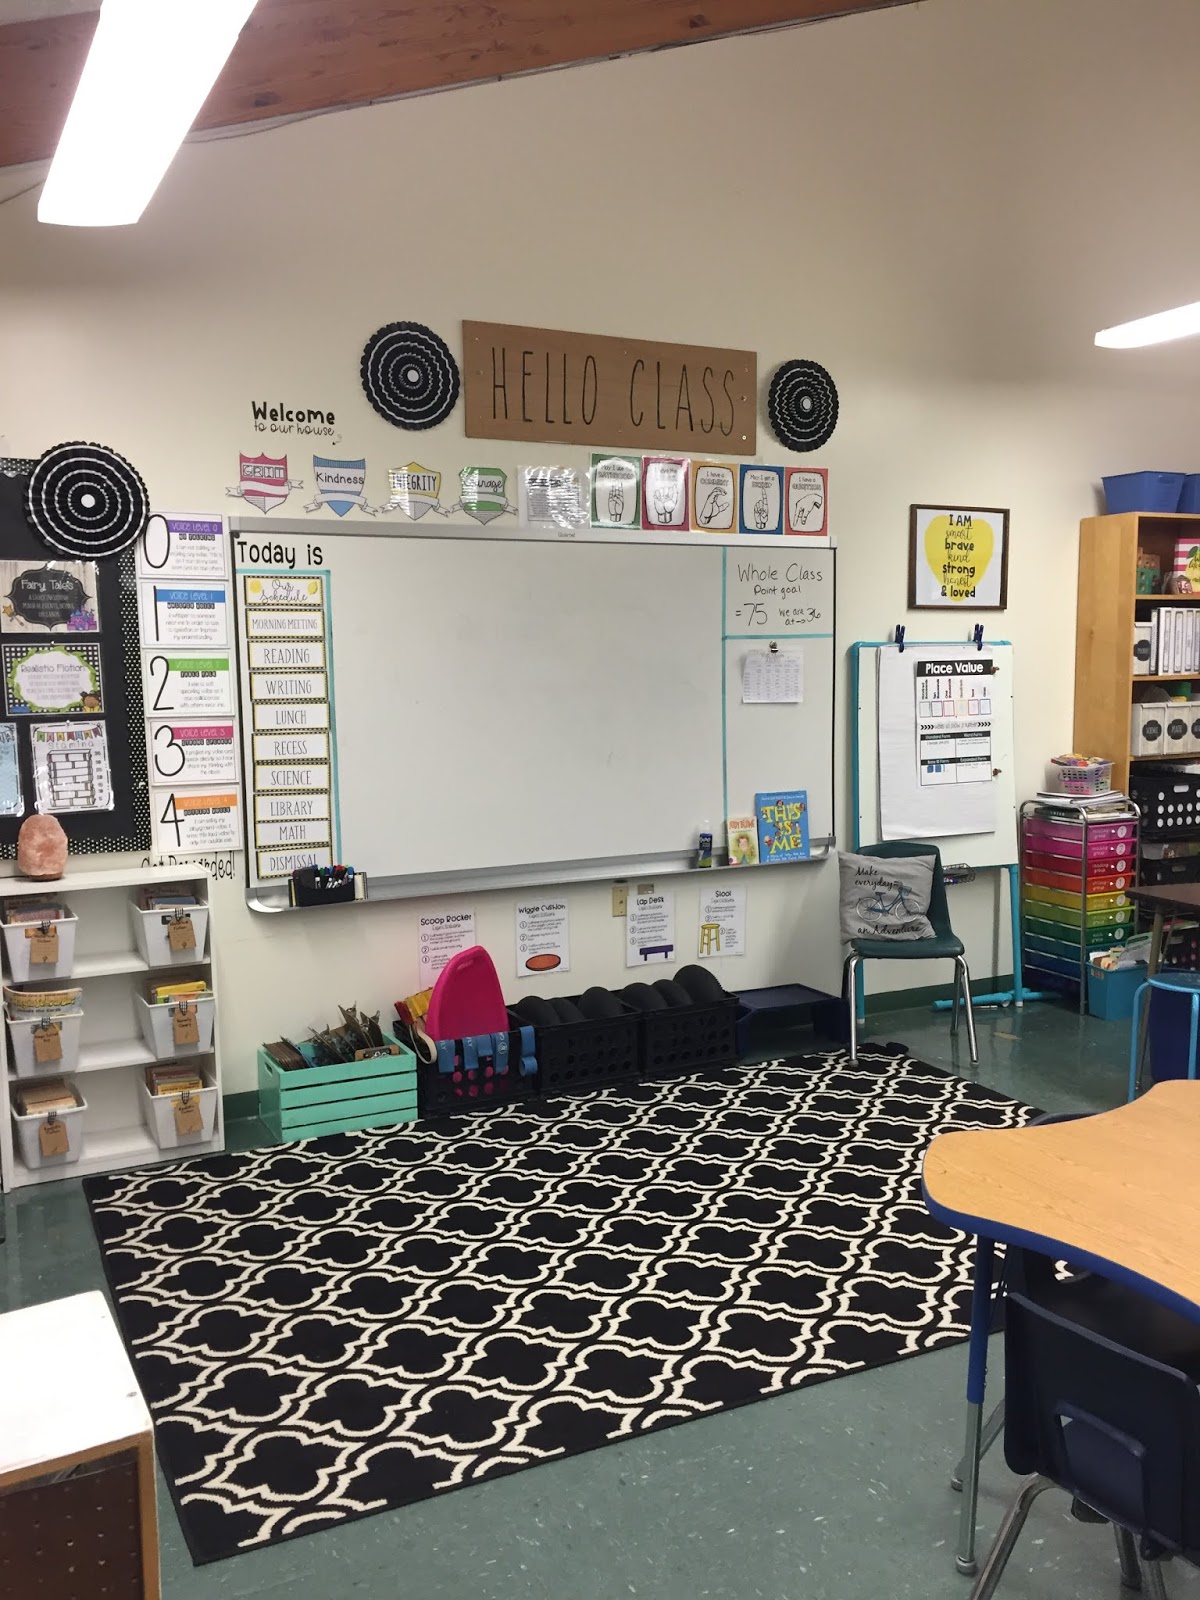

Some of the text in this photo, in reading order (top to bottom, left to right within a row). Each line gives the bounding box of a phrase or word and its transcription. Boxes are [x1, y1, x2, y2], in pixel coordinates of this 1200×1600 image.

[491, 346, 736, 437] HELLO CLASS
[251, 401, 336, 426] Welcome
[253, 422, 335, 436] to our house
[242, 463, 285, 479] GRIT
[316, 472, 364, 485] Kindness
[392, 472, 437, 493] INTEGRITY
[171, 522, 190, 531] VOICE
[192, 523, 210, 532] LEVEL
[949, 514, 972, 527] I AM
[945, 538, 974, 551] brave
[237, 541, 296, 569] Today
[307, 544, 323, 565] is
[738, 563, 823, 583] Whole Class
[942, 562, 976, 578] strong
[21, 579, 74, 592] Fairy Tales
[754, 585, 801, 600] Point goal
[941, 585, 976, 597] & loved
[169, 591, 188, 601] VOICE
[190, 591, 208, 601] LEVEL
[792, 608, 804, 616] are
[252, 618, 318, 630] MORNING MEETING
[263, 648, 311, 664] READING
[20, 663, 86, 673] Realistic Fiction
[925, 662, 984, 675] Place Value
[149, 655, 174, 711] 2
[265, 679, 312, 695] WRITING
[275, 710, 307, 725] LUNCH
[180, 728, 199, 738] VOICE
[200, 728, 218, 737] LEVEL
[48, 740, 94, 750] Stamina
[154, 724, 185, 777] 3
[273, 740, 308, 756] RECESS
[270, 770, 312, 786] SCIENCE
[270, 800, 313, 817] LIBRARY
[761, 802, 802, 823] THIS
[160, 792, 185, 847] 4
[279, 825, 306, 841] MATH
[769, 834, 803, 854] ME
[855, 866, 879, 876] Make
[636, 896, 664, 906] Lap Desk
[715, 890, 732, 898] Stool
[518, 906, 540, 914] Wiggle
[420, 914, 472, 926] Scoop Rocker
[872, 924, 921, 935] Adventure
